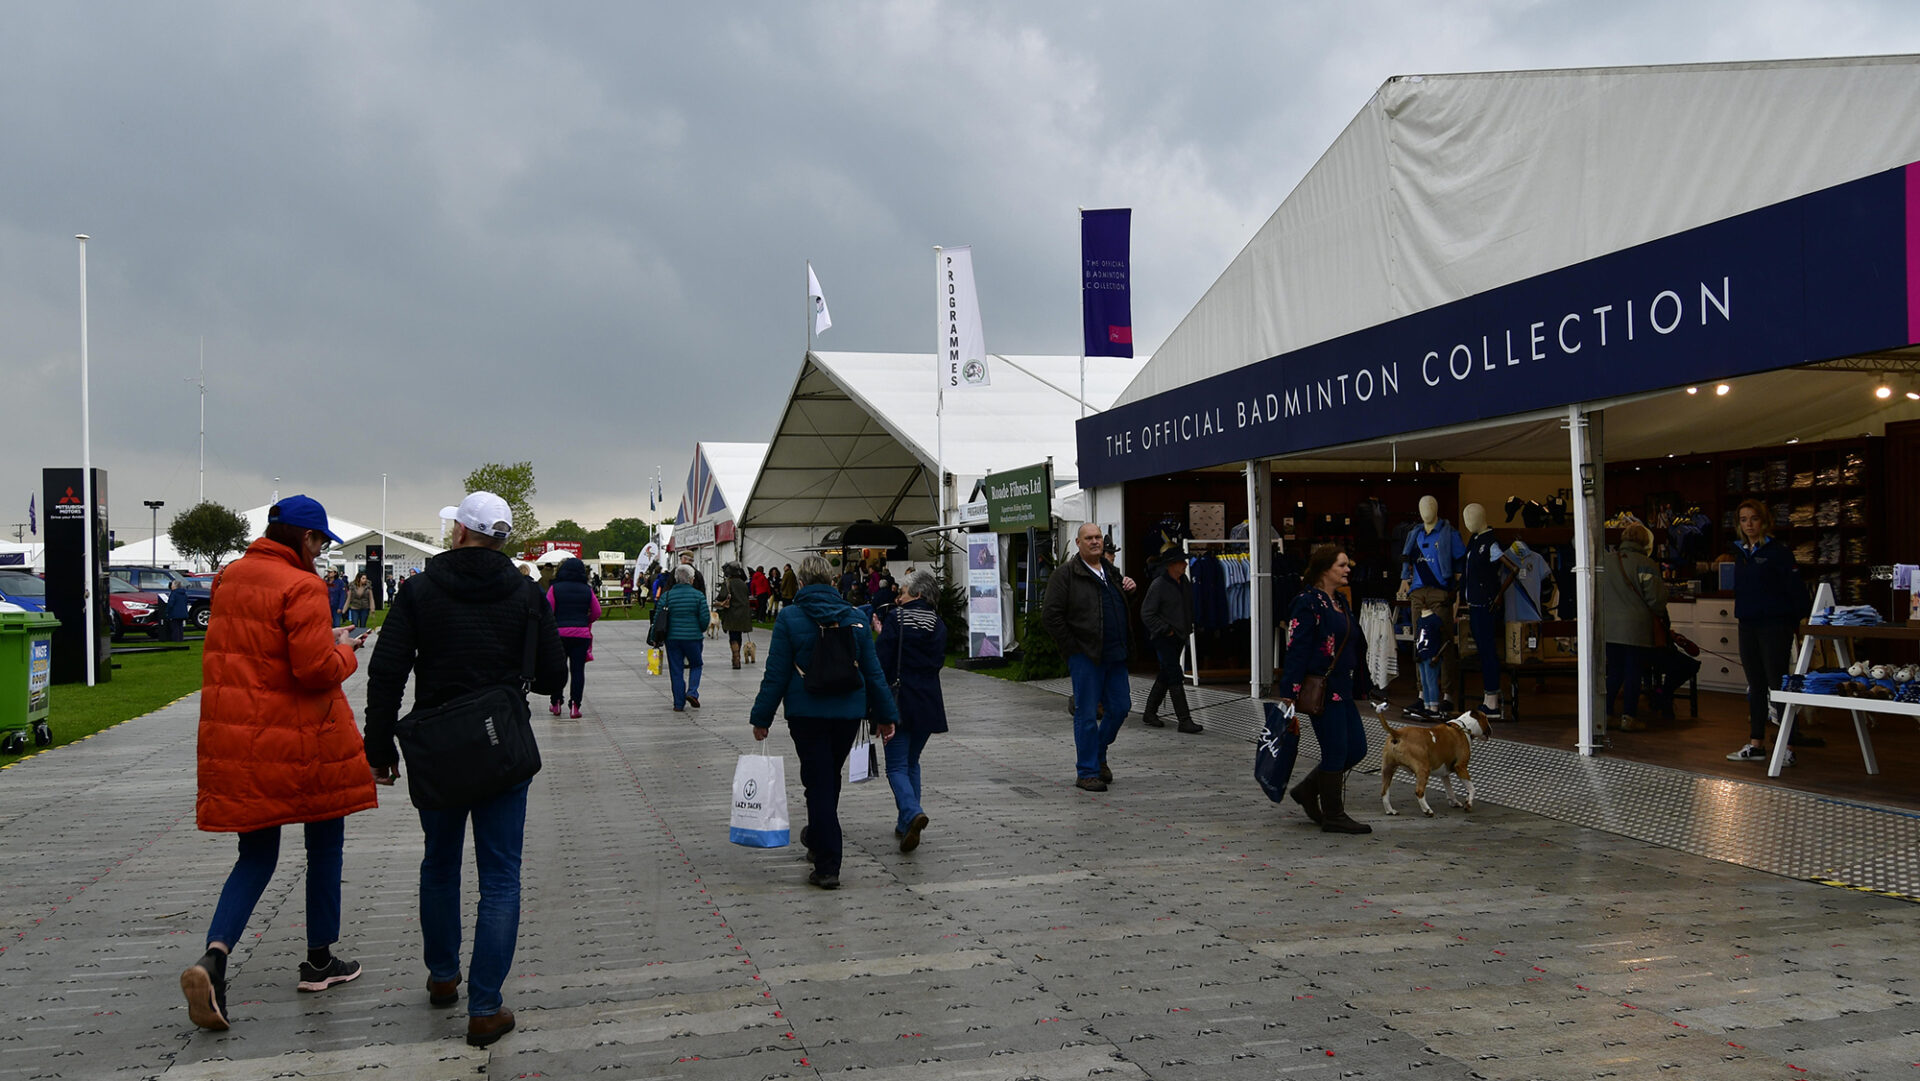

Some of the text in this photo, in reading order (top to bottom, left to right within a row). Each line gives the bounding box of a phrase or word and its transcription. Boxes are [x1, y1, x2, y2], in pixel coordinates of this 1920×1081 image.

[1086, 270, 1125, 279] BADMINTON
[1086, 281, 1125, 290] COLLECTION
[947, 257, 959, 386] PROGRAMMES
[1106, 276, 1730, 457] THE OFFICIAL BADMINTON COLLECTION
[991, 477, 1041, 500] Roade Fibres Ltd
[485, 716, 499, 746] THULE
[735, 801, 747, 809] LAZY
